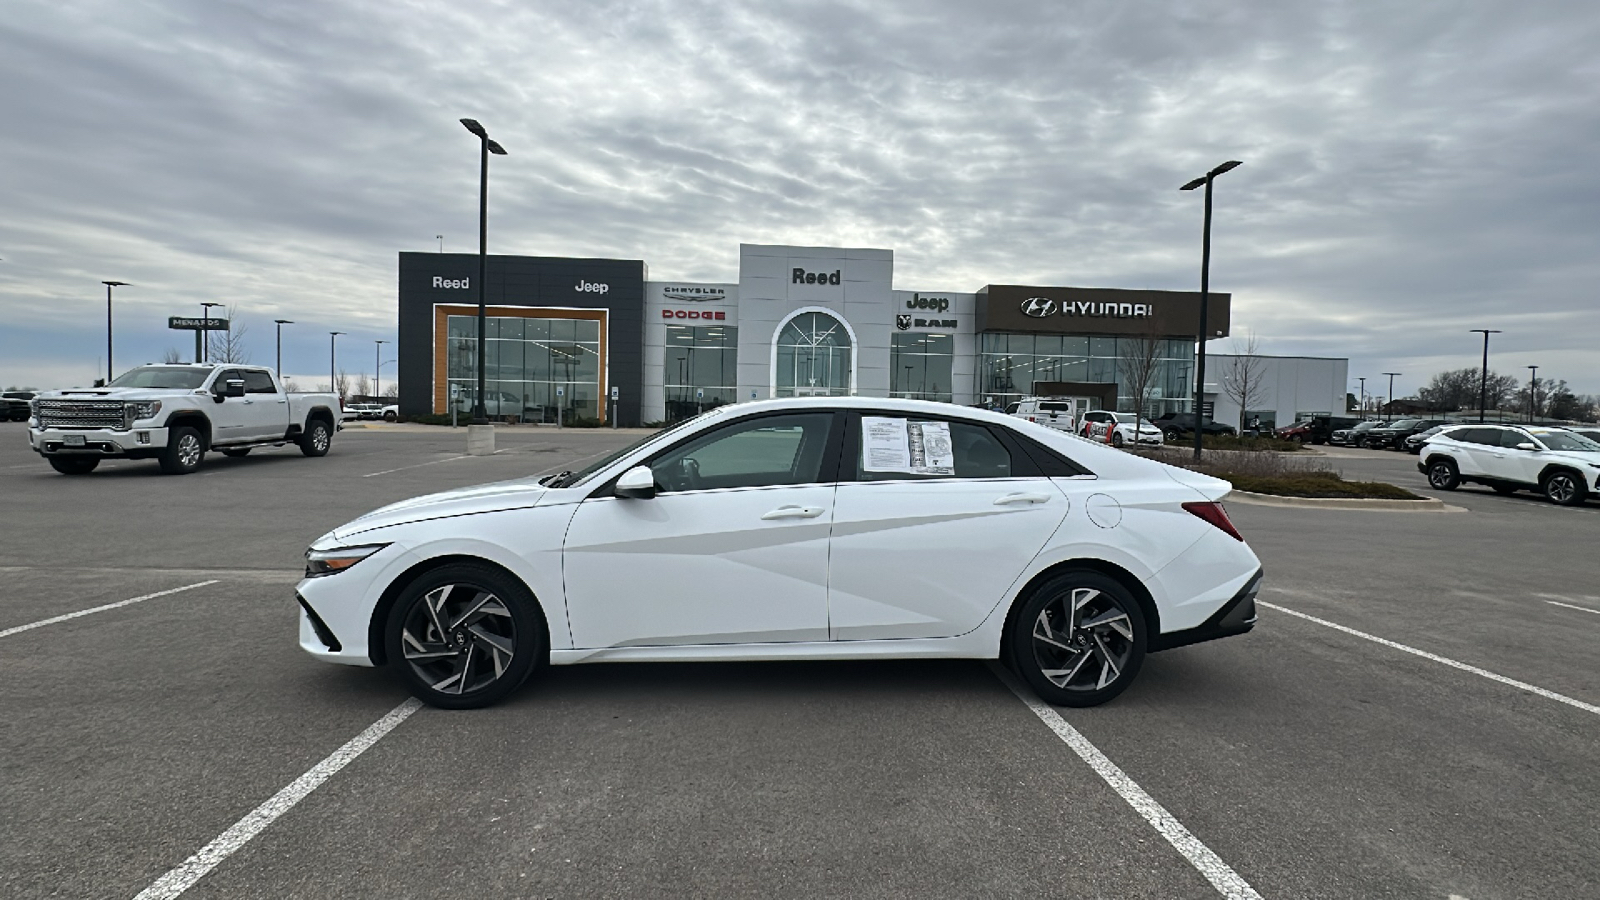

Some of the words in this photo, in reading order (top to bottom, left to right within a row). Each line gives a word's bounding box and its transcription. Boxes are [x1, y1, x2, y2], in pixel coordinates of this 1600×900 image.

[432, 276, 470, 289] Reed
[792, 267, 841, 286] Reed
[575, 280, 609, 295] Jeep
[663, 286, 725, 295] CHRYSLER
[906, 293, 949, 313] Jeep
[1062, 301, 1153, 317] HYUNDAI
[662, 309, 726, 321] DODGE
[914, 318, 958, 329] RAM
